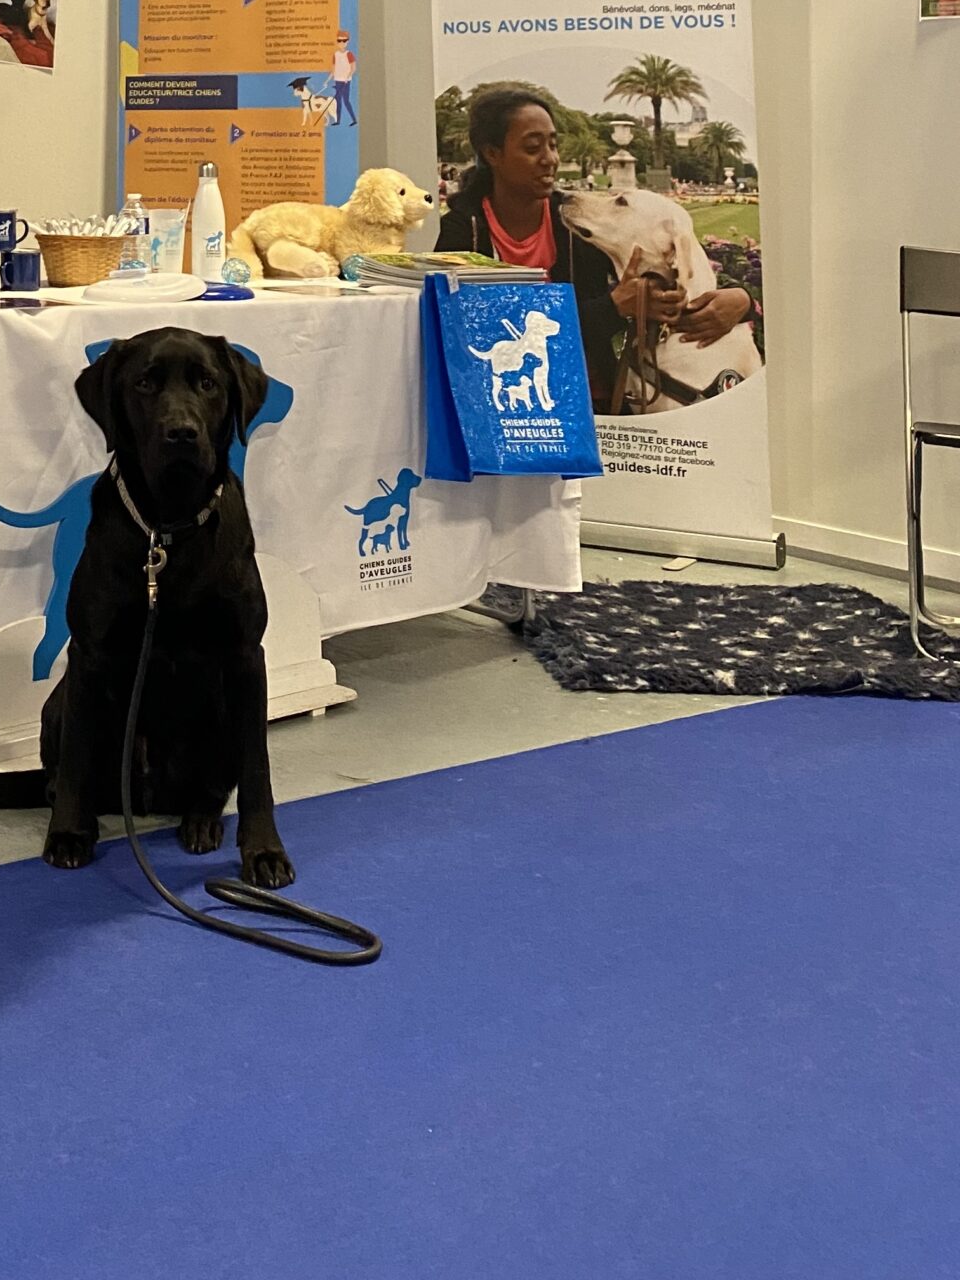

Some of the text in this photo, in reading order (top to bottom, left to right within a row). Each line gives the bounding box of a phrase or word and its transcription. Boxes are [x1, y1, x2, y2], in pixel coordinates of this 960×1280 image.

[698, 3, 736, 11] mécénat
[443, 14, 736, 34] NOUS AVONS BESOIN DE VOUS !
[129, 89, 194, 97] EDUCATEUR/TRICE
[500, 418, 561, 426] CHIENS GUIDES
[504, 429, 564, 438] D'AVEUGLES
[601, 440, 697, 456] RD 319 77170 Coubert
[631, 435, 654, 444] D'ILE
[656, 437, 669, 445] DE
[671, 439, 708, 449] FRANCE
[601, 449, 661, 462] Rejoignez-nous
[678, 456, 715, 466] facebook
[360, 556, 411, 570] CHIENS GUIDES
[360, 564, 412, 579] D'AVEUGLES
